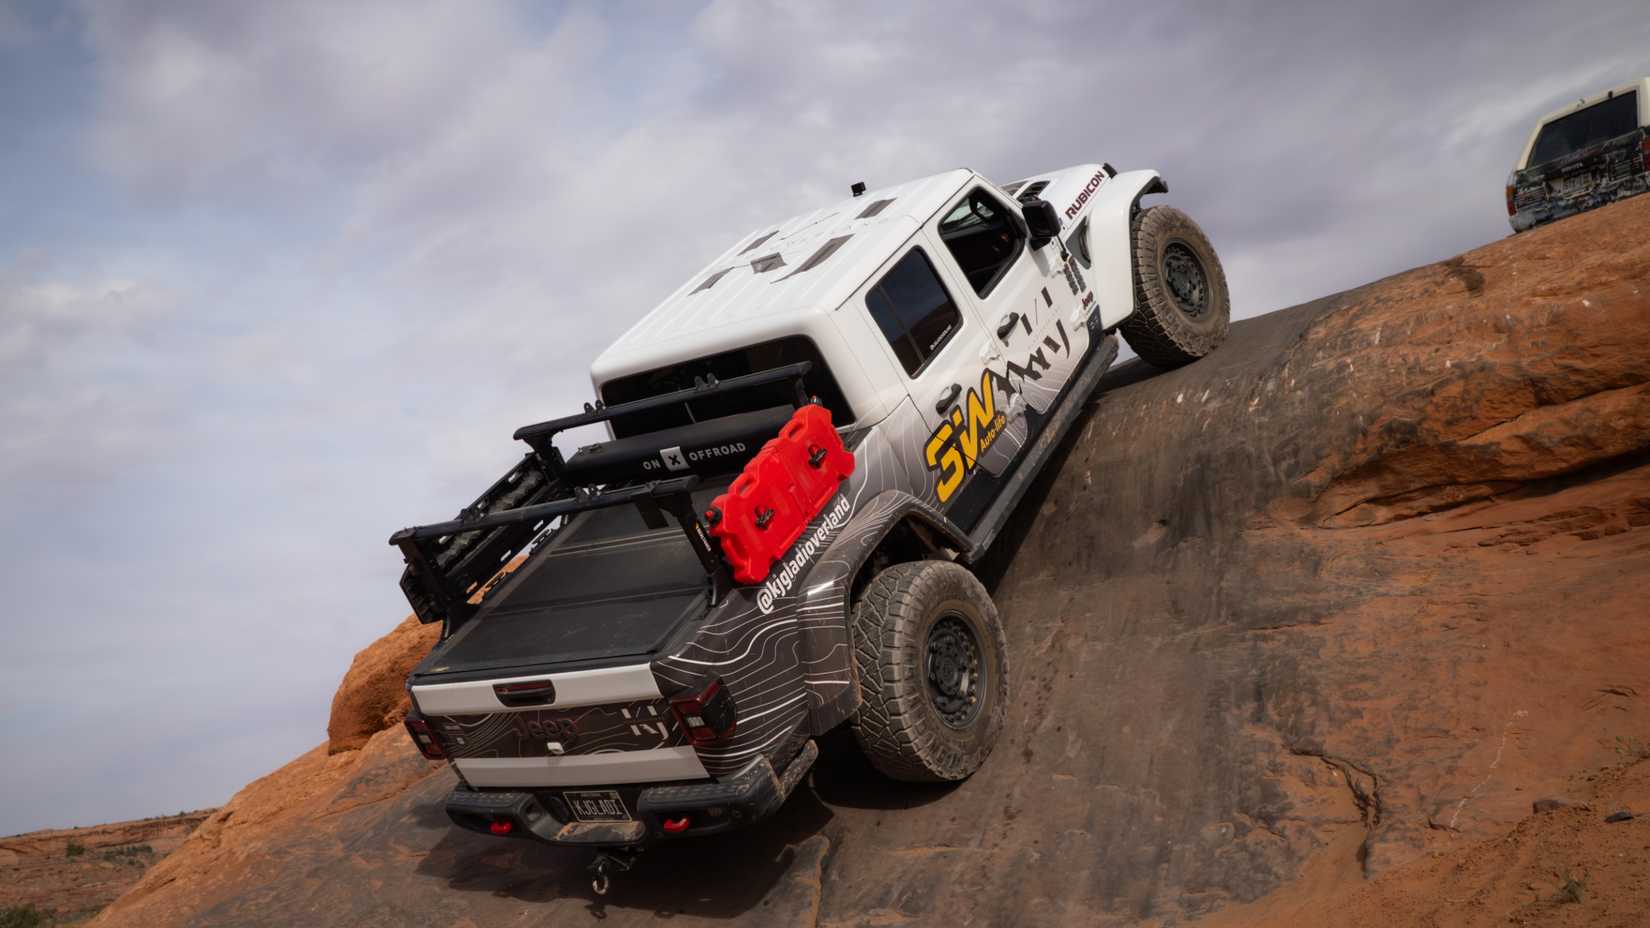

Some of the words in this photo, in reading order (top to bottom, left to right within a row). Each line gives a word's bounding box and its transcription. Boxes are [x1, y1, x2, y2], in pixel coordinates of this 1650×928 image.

[1065, 170, 1105, 219] RUBICON
[642, 459, 661, 470] ON
[688, 442, 746, 461] OFFROAD
[756, 494, 850, 614] @kjgladioverland
